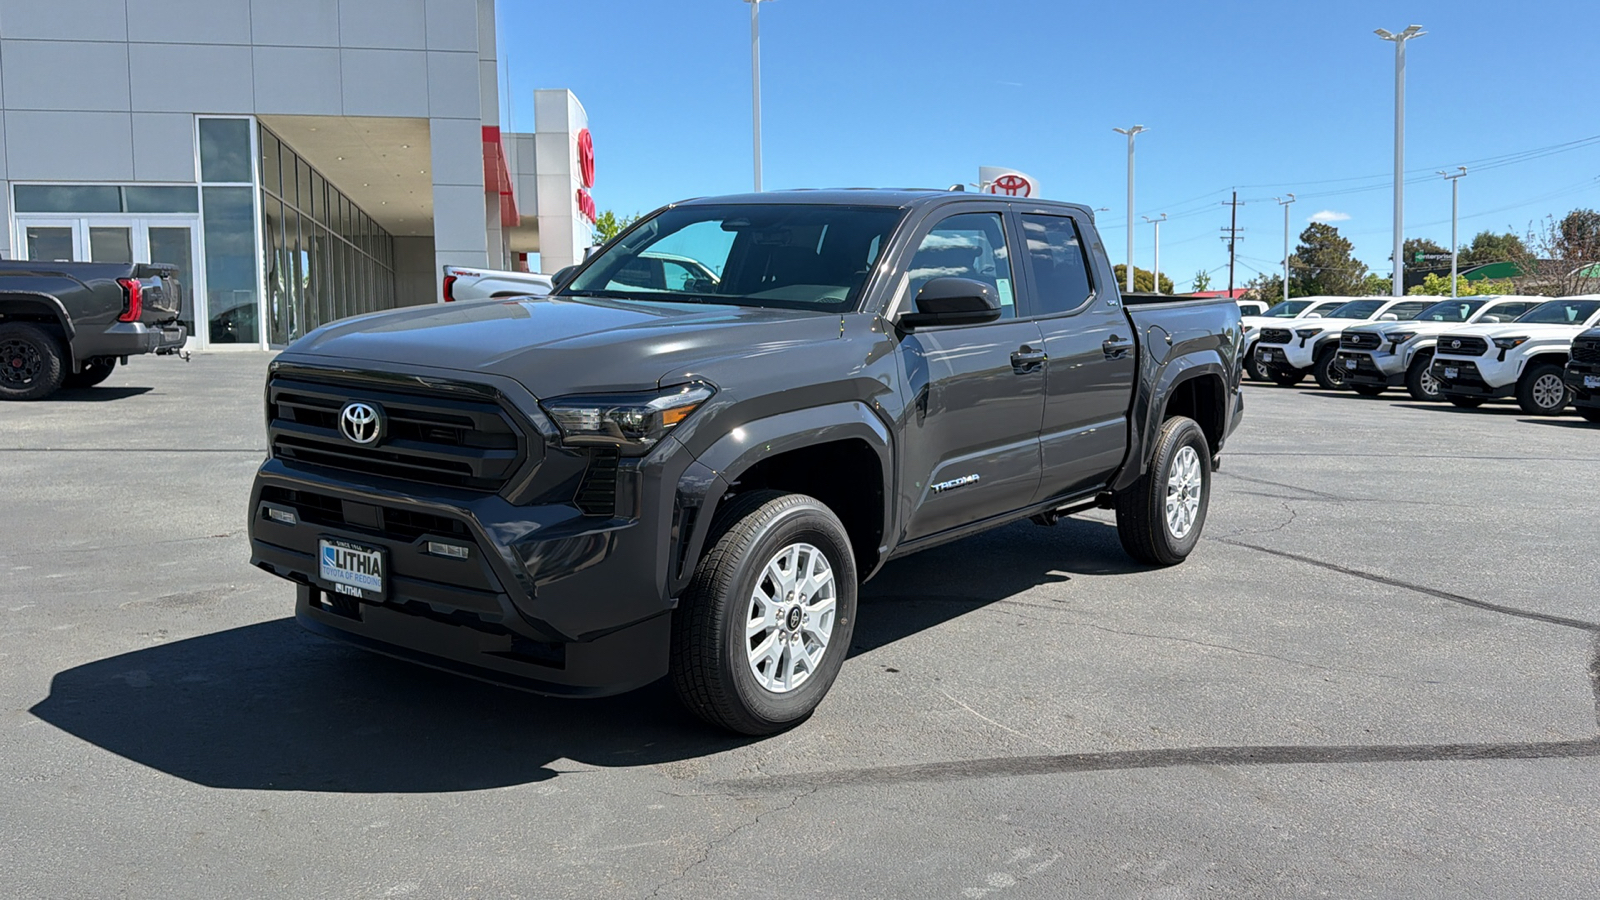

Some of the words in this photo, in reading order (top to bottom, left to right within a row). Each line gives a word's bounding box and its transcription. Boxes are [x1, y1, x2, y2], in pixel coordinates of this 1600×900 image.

[930, 473, 980, 491] TACOMA
[335, 549, 381, 577] LITHIA
[323, 566, 344, 578] TOYOTA
[345, 570, 353, 580] OF
[354, 573, 381, 587] REDDING
[341, 584, 363, 598] LITHIA
